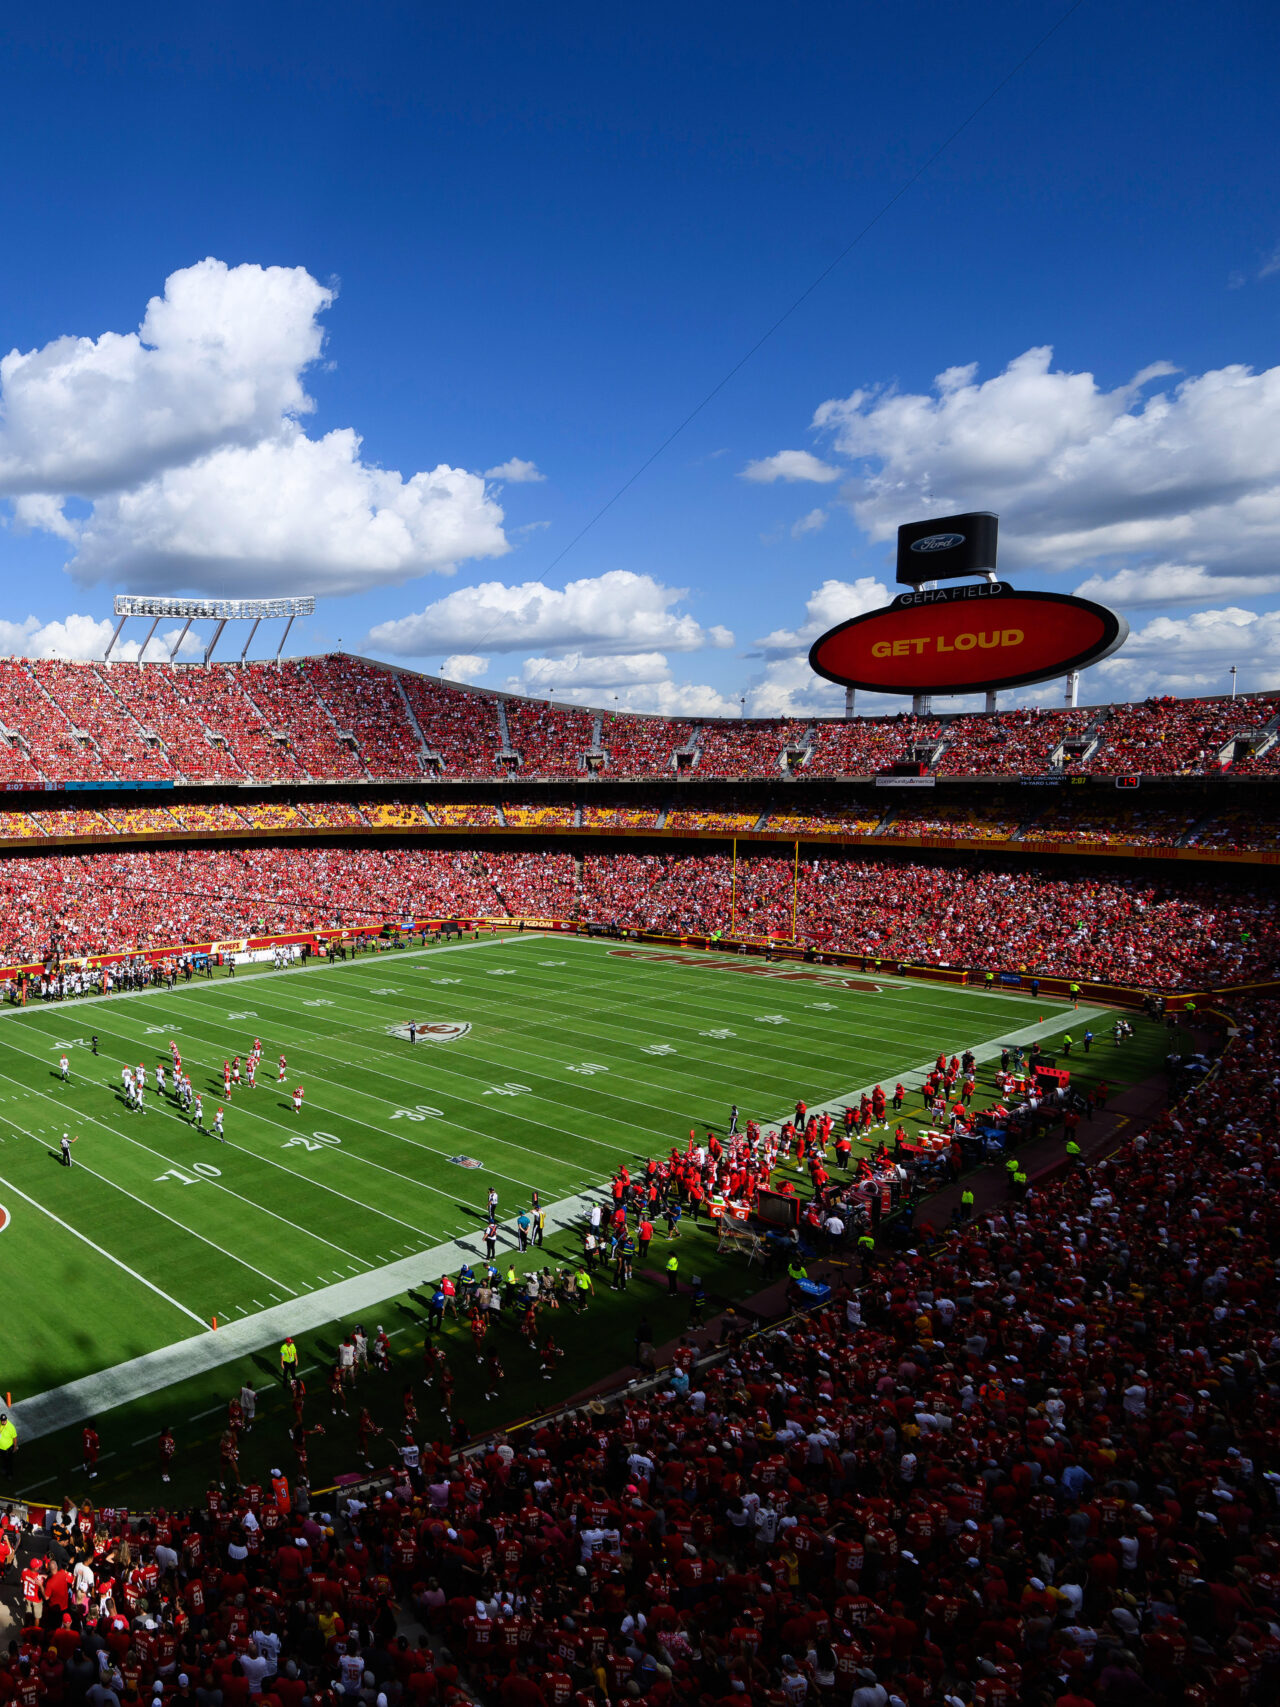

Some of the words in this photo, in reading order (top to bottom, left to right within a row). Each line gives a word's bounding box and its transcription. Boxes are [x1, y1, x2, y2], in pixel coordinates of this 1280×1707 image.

[920, 536, 953, 551] Ford
[900, 590, 947, 605] GEHA
[952, 583, 1002, 599] FIELD
[871, 637, 930, 658] GET
[936, 629, 1025, 653] LOUD
[1123, 777, 1136, 787] 19
[218, 942, 241, 951] CHIEFS
[606, 949, 913, 993] CHIEFS
[574, 1062, 609, 1076] 50
[490, 1082, 532, 1097] 40
[392, 1105, 444, 1121] 30
[288, 1131, 341, 1151] 20
[163, 1162, 222, 1186] 10
[712, 1207, 721, 1216] G
[735, 1210, 745, 1219] G
[505, 1551, 518, 1562] 95
[23, 1579, 36, 1597] 15
[476, 1631, 489, 1643] 15
[506, 1633, 517, 1644] 15
